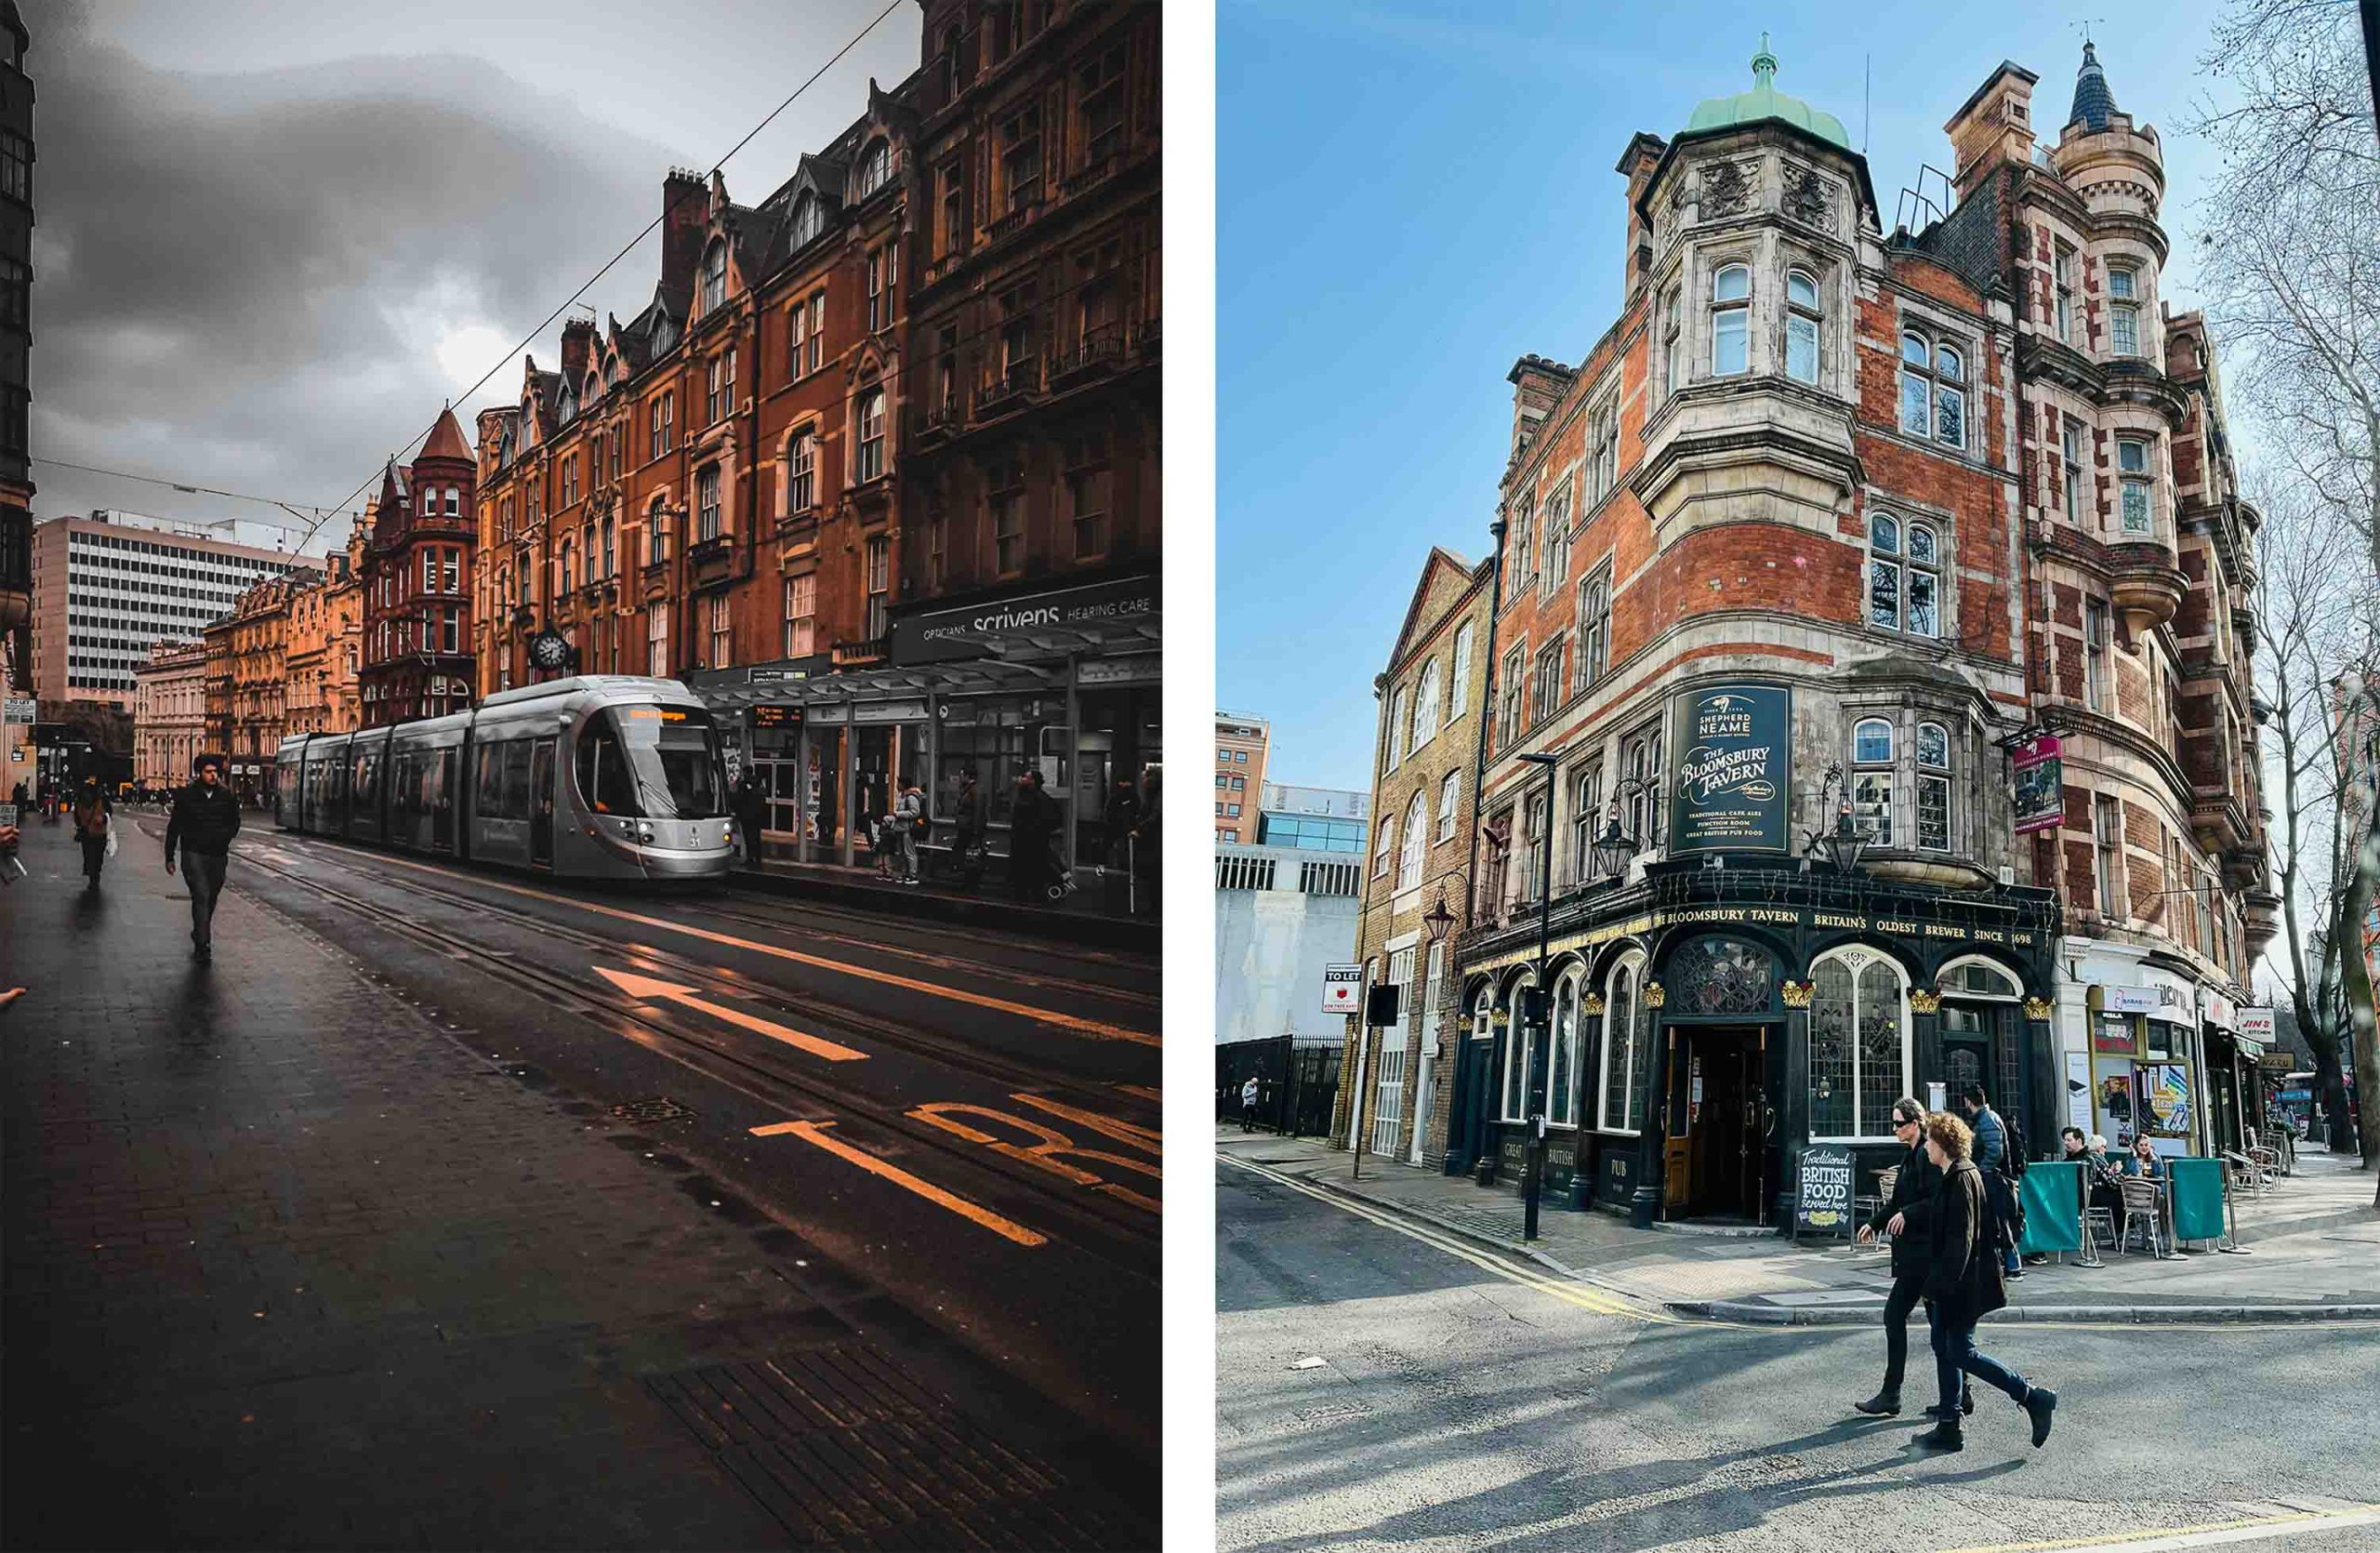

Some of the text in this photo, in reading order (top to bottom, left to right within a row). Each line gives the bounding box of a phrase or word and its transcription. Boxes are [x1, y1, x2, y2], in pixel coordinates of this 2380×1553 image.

[923, 598, 1151, 641] OPTICIANS scrivens HEARING CARE
[1699, 713, 1752, 724] SHEPHERD
[1699, 722, 1751, 735] NEAME
[1703, 748, 1724, 762] THE
[1681, 746, 1770, 790] BLOOMSBURY
[1698, 763, 1767, 798] TAVERN
[690, 838, 700, 847] 31
[1667, 909, 1746, 925] BLOOMSBURY
[1750, 909, 1799, 923] TAVERN
[1814, 913, 1867, 929] BRITAIN'S
[1876, 920, 1917, 934] OLDEST
[1925, 924, 1966, 938] BREWER
[1974, 929, 2003, 942] SINCE
[2011, 933, 2031, 945] 1698
[1504, 1142, 1524, 1159] GREAT
[1548, 1148, 1574, 1166] BRITISH
[1802, 1148, 1850, 1165] Traditional
[1611, 1160, 1627, 1177] PUB
[1802, 1166, 1850, 1185] BRITISH
[1803, 1184, 1846, 1199] FOOD
[1802, 1199, 1848, 1210] served here
